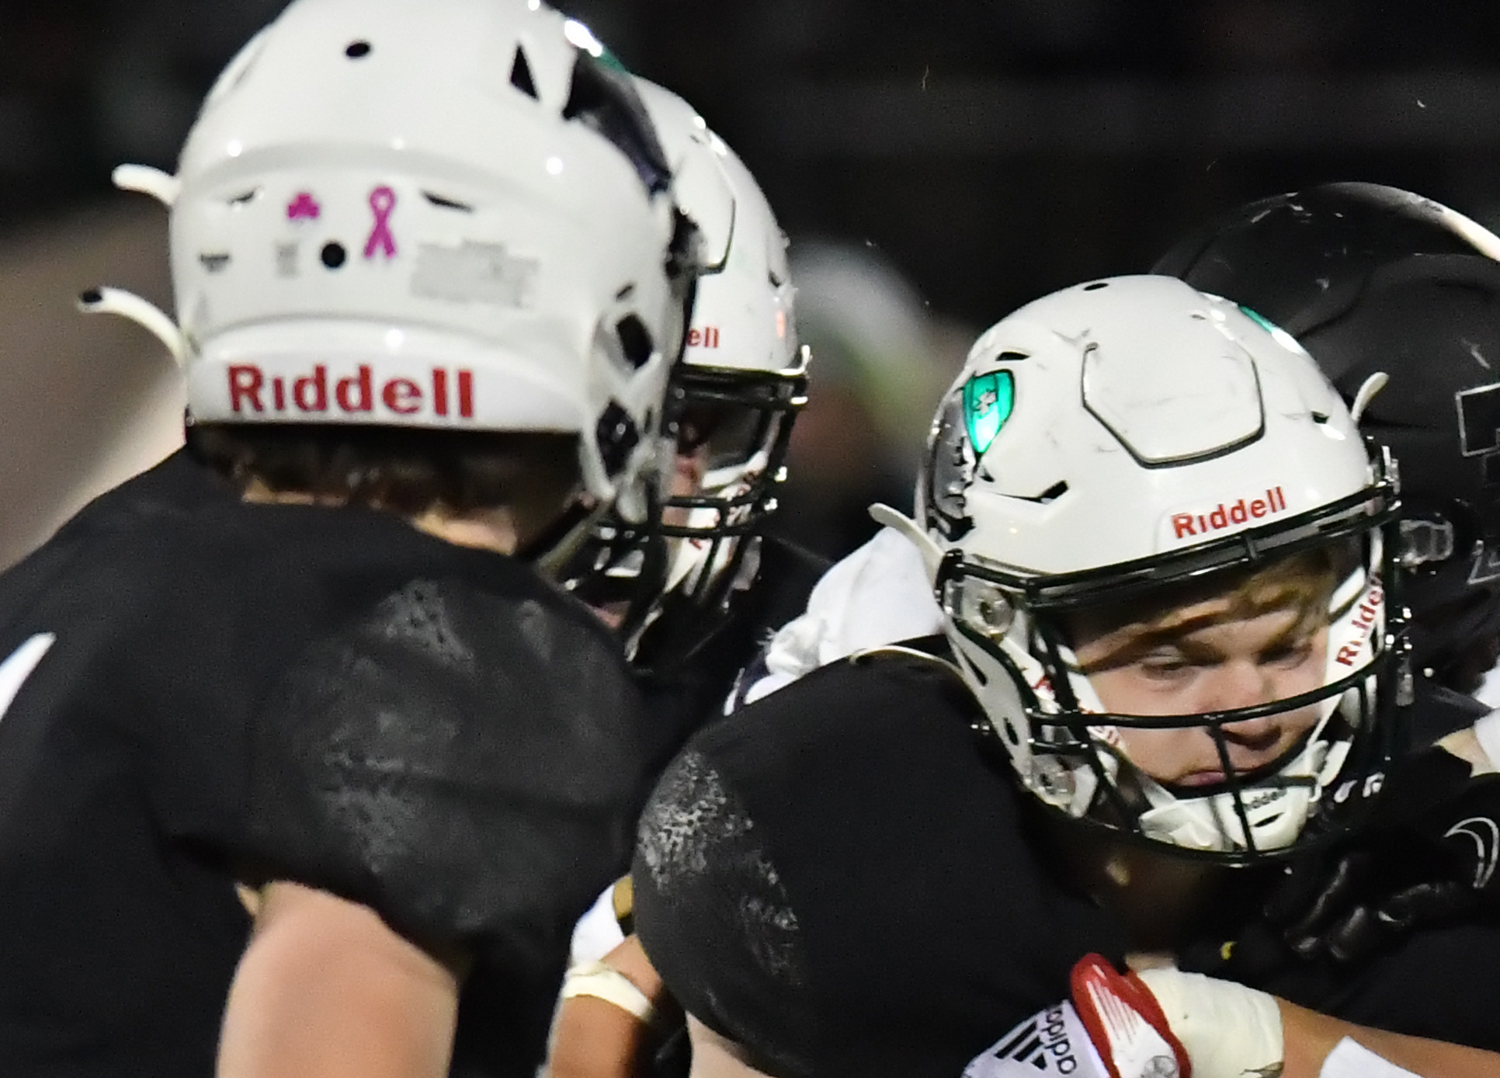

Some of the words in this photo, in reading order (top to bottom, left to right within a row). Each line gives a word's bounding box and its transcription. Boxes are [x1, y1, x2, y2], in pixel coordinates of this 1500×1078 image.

[227, 363, 475, 418] Riddell
[1171, 486, 1287, 539] Riddell
[1040, 1003, 1078, 1075] adida
